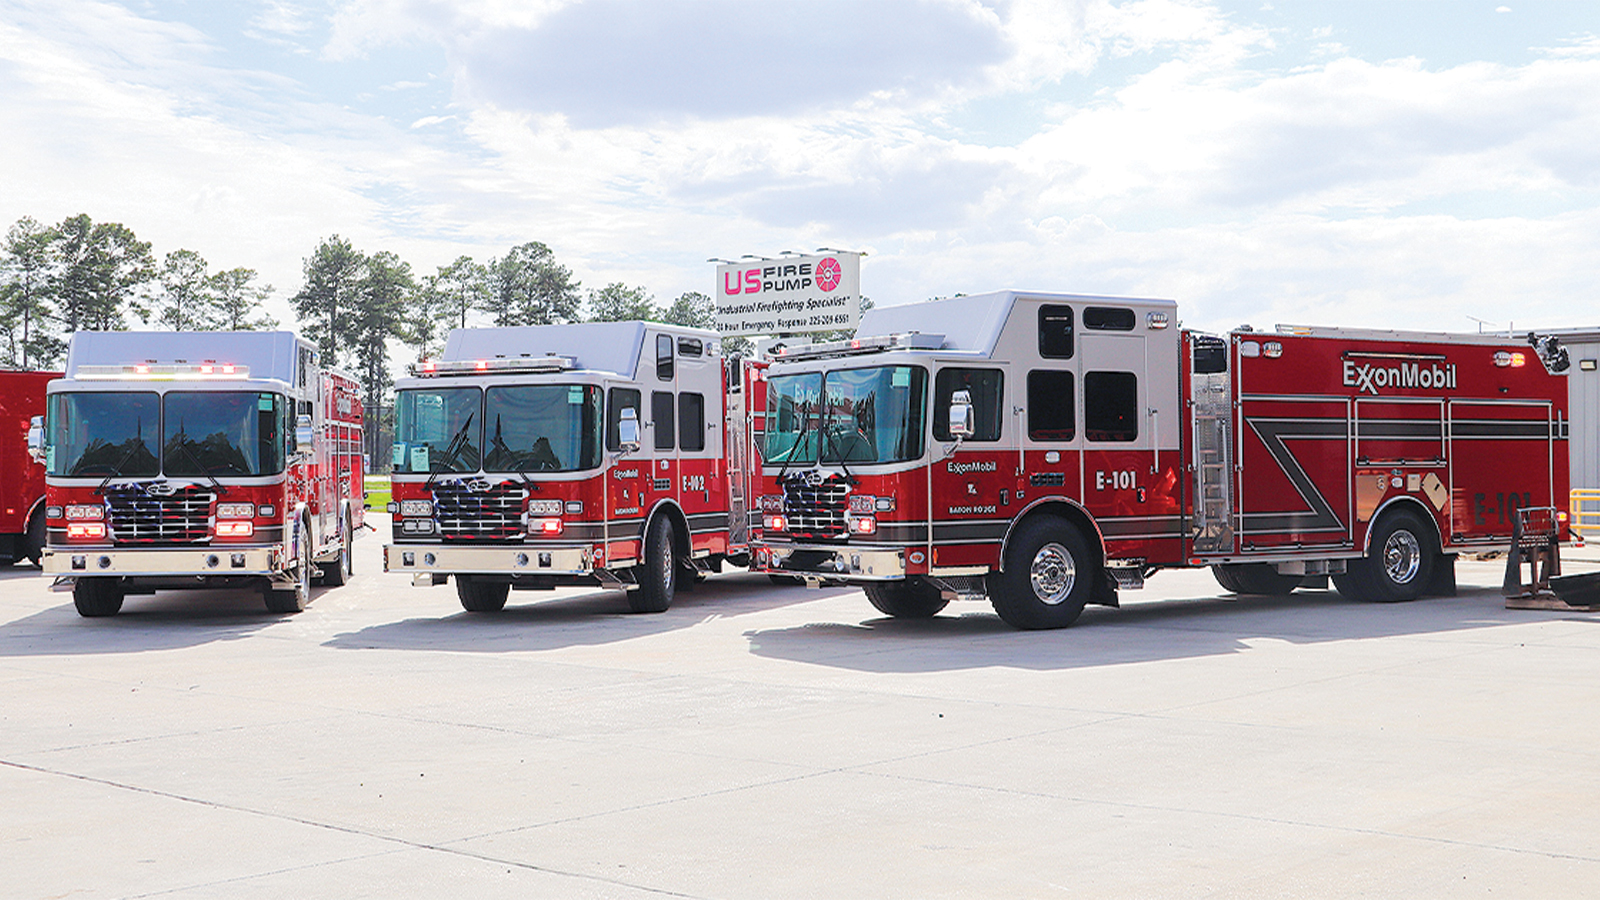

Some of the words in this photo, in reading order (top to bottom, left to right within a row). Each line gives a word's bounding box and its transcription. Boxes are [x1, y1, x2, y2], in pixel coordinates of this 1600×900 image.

[763, 263, 812, 278] FIRE
[724, 268, 761, 295] US
[763, 278, 812, 292] PUMP
[756, 299, 805, 313] Firefighting
[742, 320, 775, 332] Emergency
[1343, 360, 1457, 395] ExxonMobil
[947, 461, 997, 475] ExxonMobil
[1096, 471, 1137, 490] E-101
